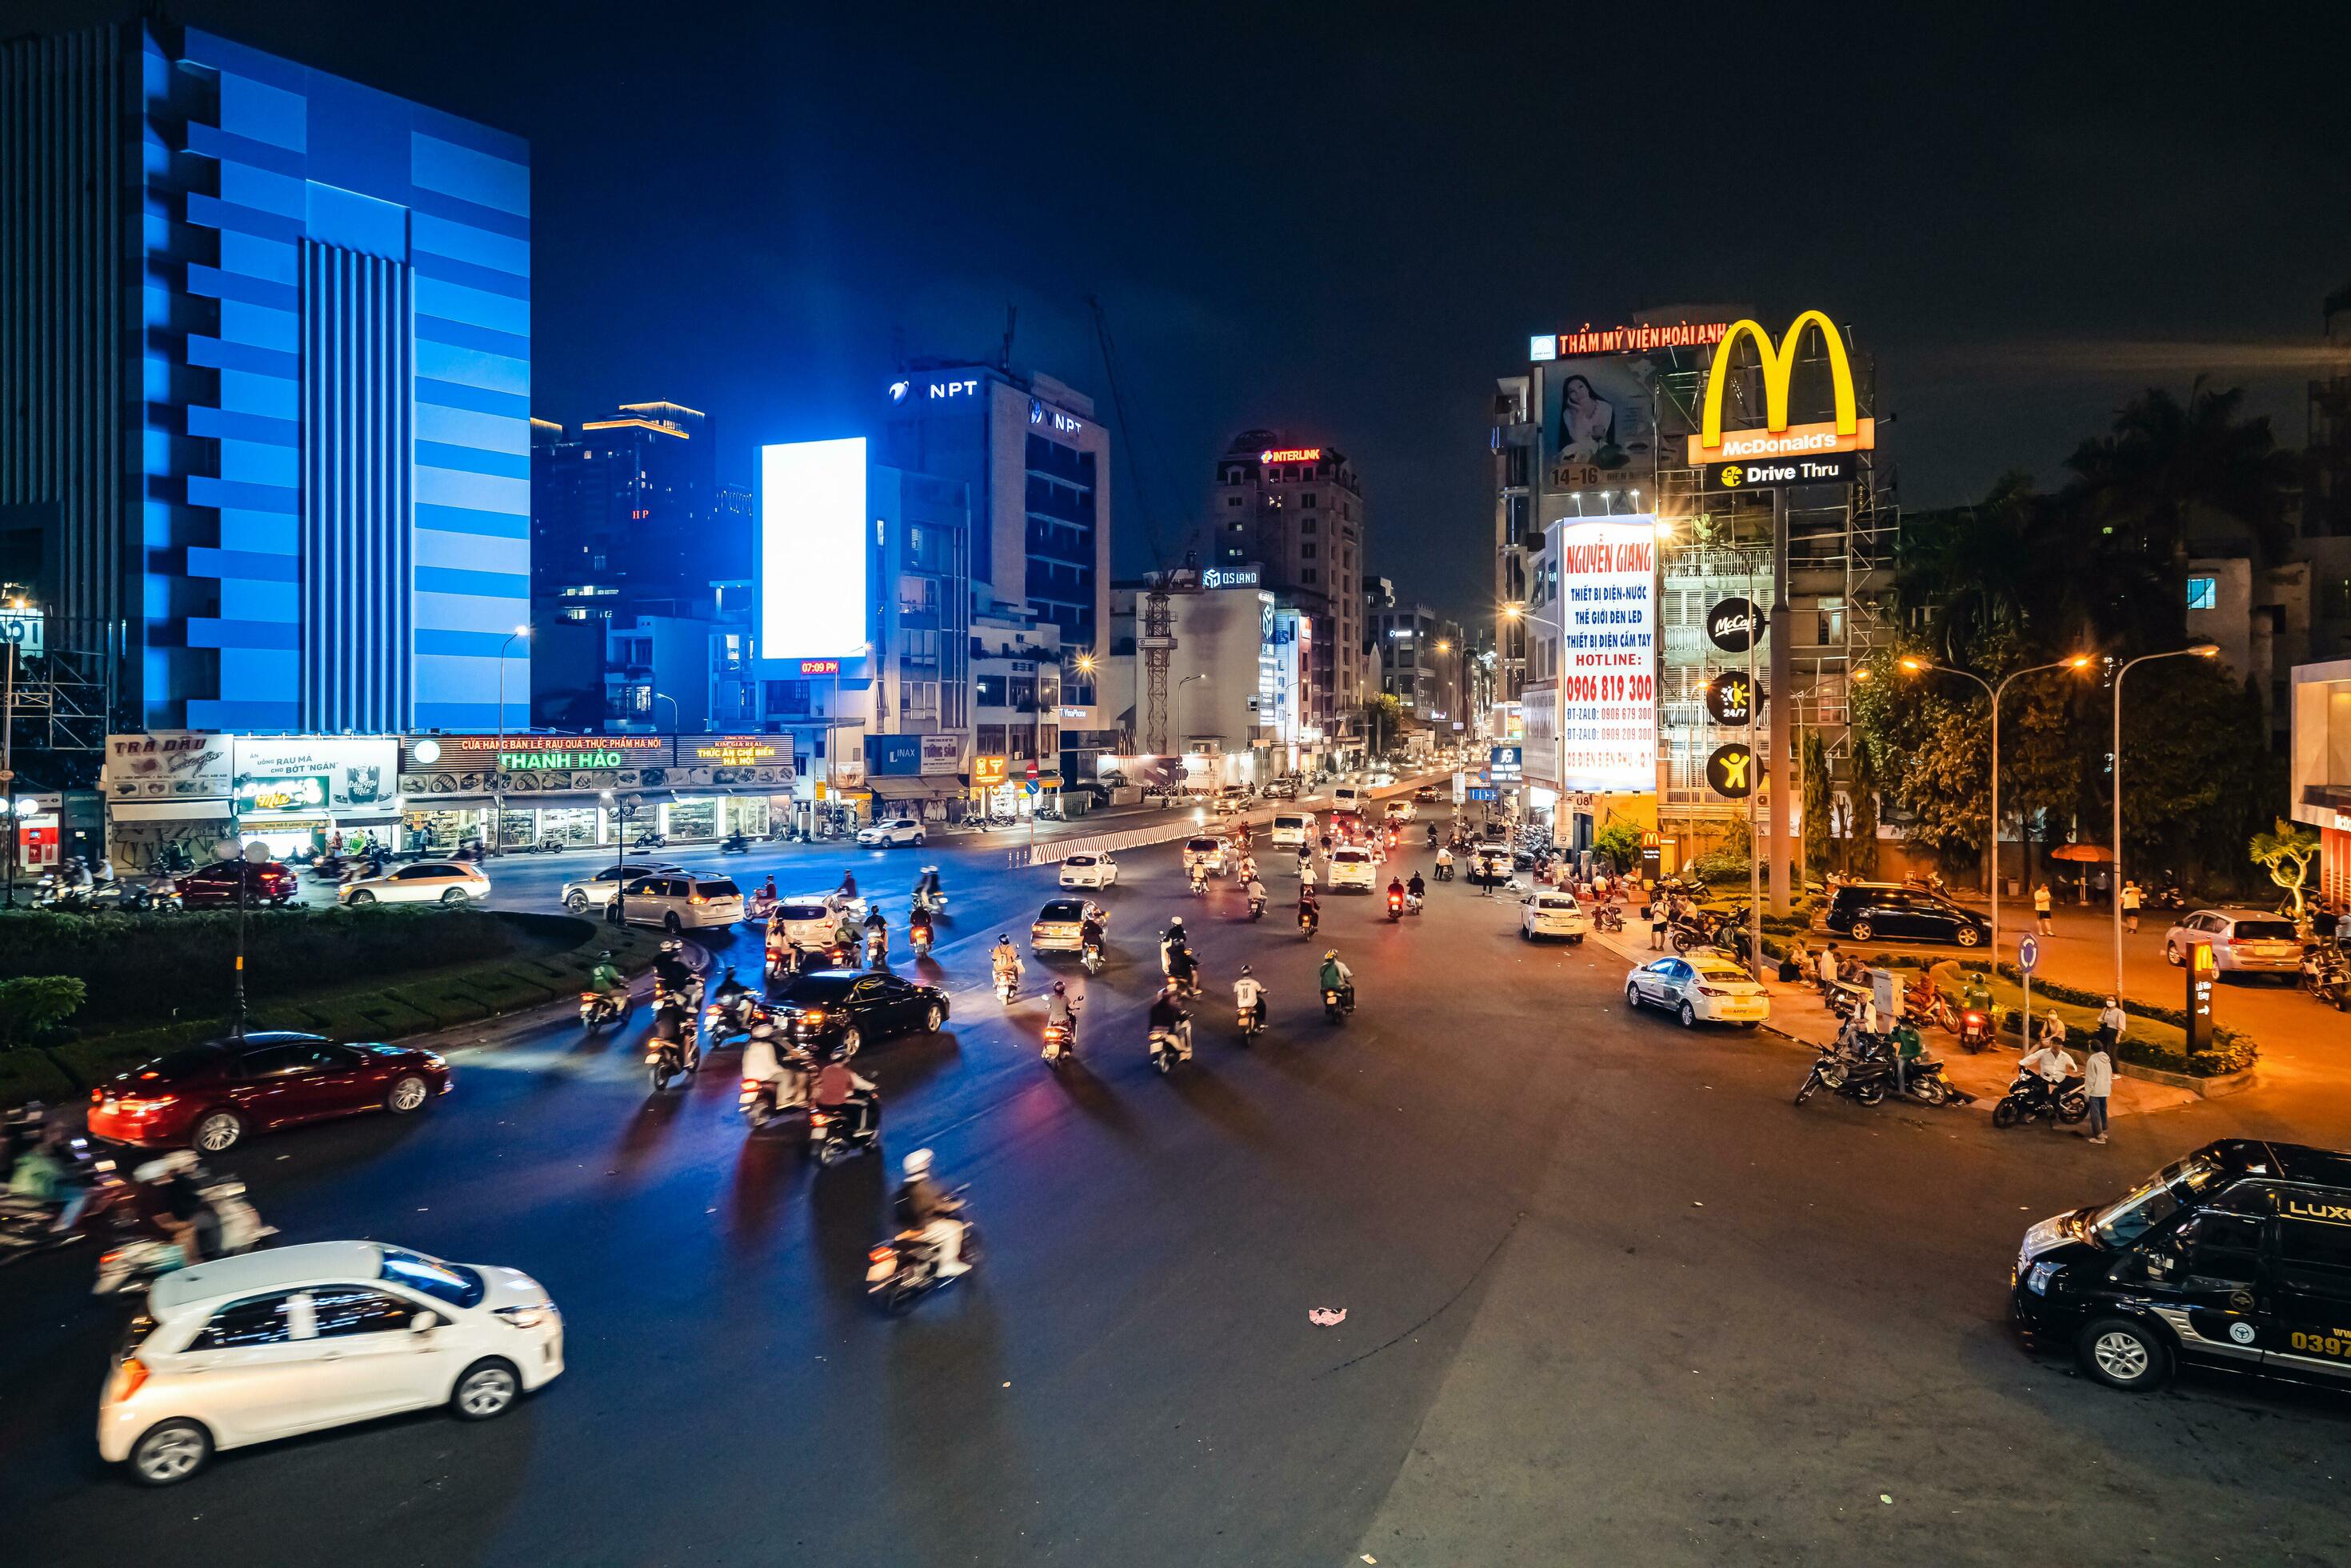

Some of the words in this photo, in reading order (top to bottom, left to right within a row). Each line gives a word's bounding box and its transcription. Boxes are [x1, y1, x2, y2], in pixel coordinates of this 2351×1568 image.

[1560, 322, 1600, 354] THẨM
[1602, 326, 1624, 352] MỸ
[1627, 322, 1661, 352] VIỆN
[1660, 320, 1695, 346] HOÀI
[1697, 323, 1727, 344] ANH
[1722, 433, 1837, 457] McDonald's
[1273, 448, 1321, 462] INTERLINK
[1552, 467, 1599, 486] 14-16
[1747, 466, 1797, 483] Drive
[1800, 462, 1839, 478] Thru
[1566, 534, 1613, 574] NGUYỄN
[1616, 542, 1652, 572] GIANG
[1236, 572, 1257, 583] LAND
[1571, 584, 1592, 602] THIẾT
[1594, 587, 1602, 604] BỊ
[1575, 608, 1589, 625] THẾ
[1592, 608, 1609, 624] GIỚI
[1609, 606, 1626, 624] ĐÈN
[1628, 610, 1642, 623] LED
[1566, 631, 1588, 648] THIẾT
[1590, 634, 1597, 651] BỊ
[1599, 633, 1618, 650] ĐIỆN
[1637, 634, 1652, 647] TAY
[1576, 654, 1642, 666] HOTLINE:
[802, 662, 825, 673] 07:09
[826, 662, 838, 673] PM
[1566, 674, 1597, 702] 0906
[1601, 674, 1625, 702] 819
[1629, 674, 1652, 702] 300
[1567, 707, 1599, 720] ĐT-ZALO:
[1601, 707, 1620, 720] 0906
[1621, 707, 1636, 720] 679
[1638, 707, 1652, 720] 300
[1722, 708, 1747, 718] 24/7
[1567, 728, 1599, 740] ĐT-ZALO:
[1601, 728, 1620, 740] 0909
[1621, 728, 1636, 740] 209
[1638, 728, 1652, 740] 300
[462, 737, 482, 750] CỬA
[482, 737, 509, 750] HÀNG
[510, 737, 528, 750] BÁN
[530, 736, 543, 750] LẺ
[545, 738, 564, 749] RAU
[564, 736, 583, 750] QUẢ
[584, 738, 608, 750] THỰC
[609, 735, 634, 748] PHẨM
[634, 737, 648, 749] HÀ
[648, 736, 662, 750] NỘI
[578, 748, 622, 768] HẢO
[698, 748, 721, 758] THỨC
[736, 746, 754, 757] CHẾ
[755, 746, 775, 756] BIẾN
[897, 748, 916, 758] INAX
[276, 758, 296, 766] RAU
[298, 754, 313, 763] MÁ
[723, 756, 737, 766] HÀ
[739, 757, 755, 766] NỘI
[285, 764, 305, 774] BỚT
[256, 794, 290, 808] Mix
